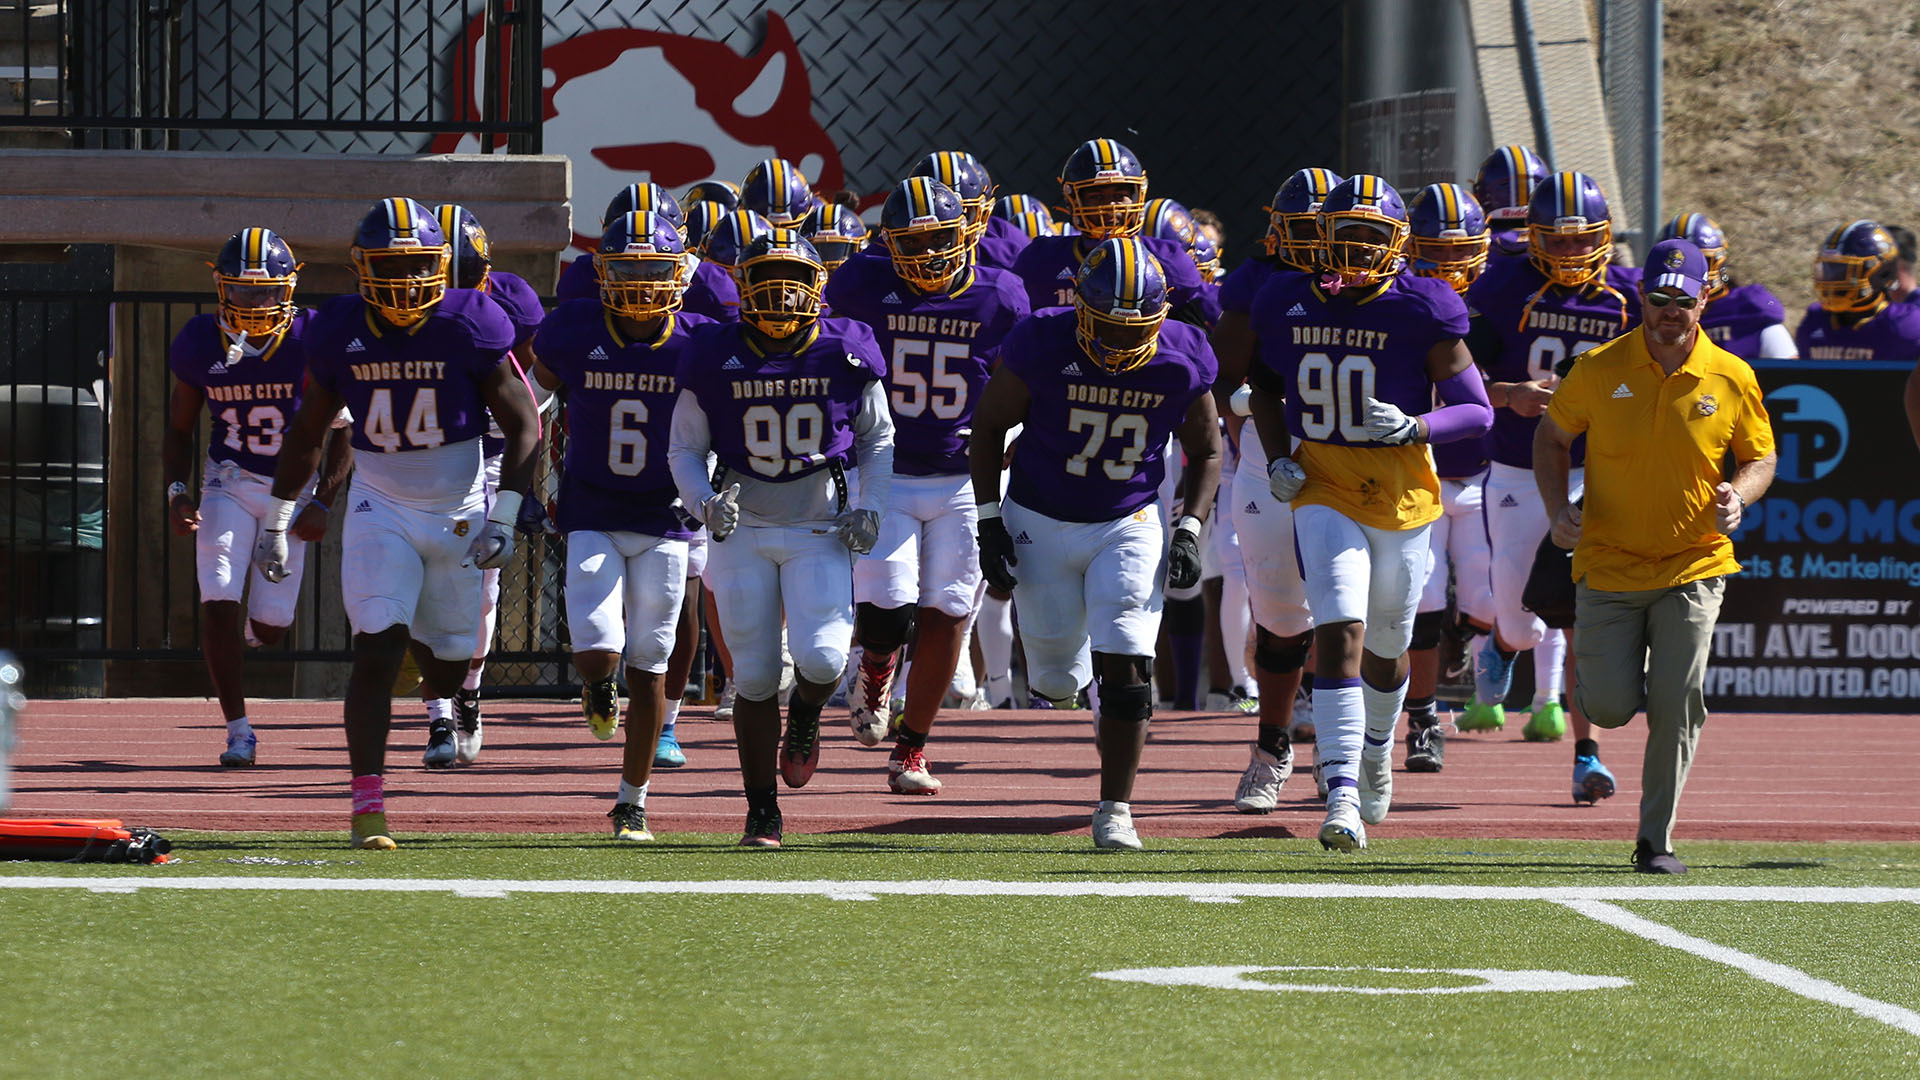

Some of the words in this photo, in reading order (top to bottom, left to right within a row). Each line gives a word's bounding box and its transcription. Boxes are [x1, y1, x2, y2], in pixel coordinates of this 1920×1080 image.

[887, 314, 937, 333] DODGE
[941, 317, 982, 338] CITY
[1292, 326, 1342, 345] DODGE
[1345, 328, 1388, 350] CITY
[1529, 311, 1576, 332] DODGE
[1579, 318, 1618, 339] CITY
[351, 362, 400, 382] DODGE
[404, 361, 446, 380] CITY
[585, 371, 634, 391] DODGE
[638, 374, 676, 393] CITY
[891, 338, 970, 420] 55
[207, 385, 252, 401] DODGE
[256, 383, 294, 399] CITY
[732, 380, 784, 399] DODGE
[790, 378, 831, 398] CITY
[1067, 384, 1119, 405] DODGE
[1122, 388, 1164, 409] CITY
[1298, 352, 1376, 442] 90
[220, 406, 285, 456] 13
[365, 388, 445, 454] 44
[608, 399, 649, 477] 6
[743, 403, 824, 478] 99
[1065, 407, 1149, 481] 73
[1729, 555, 1772, 579] cts
[1779, 555, 1795, 578] &
[1801, 553, 1920, 587] Marketing
[1783, 599, 1880, 615] POWERED
[1883, 600, 1912, 615] BY
[1763, 624, 1838, 660] AVE.
